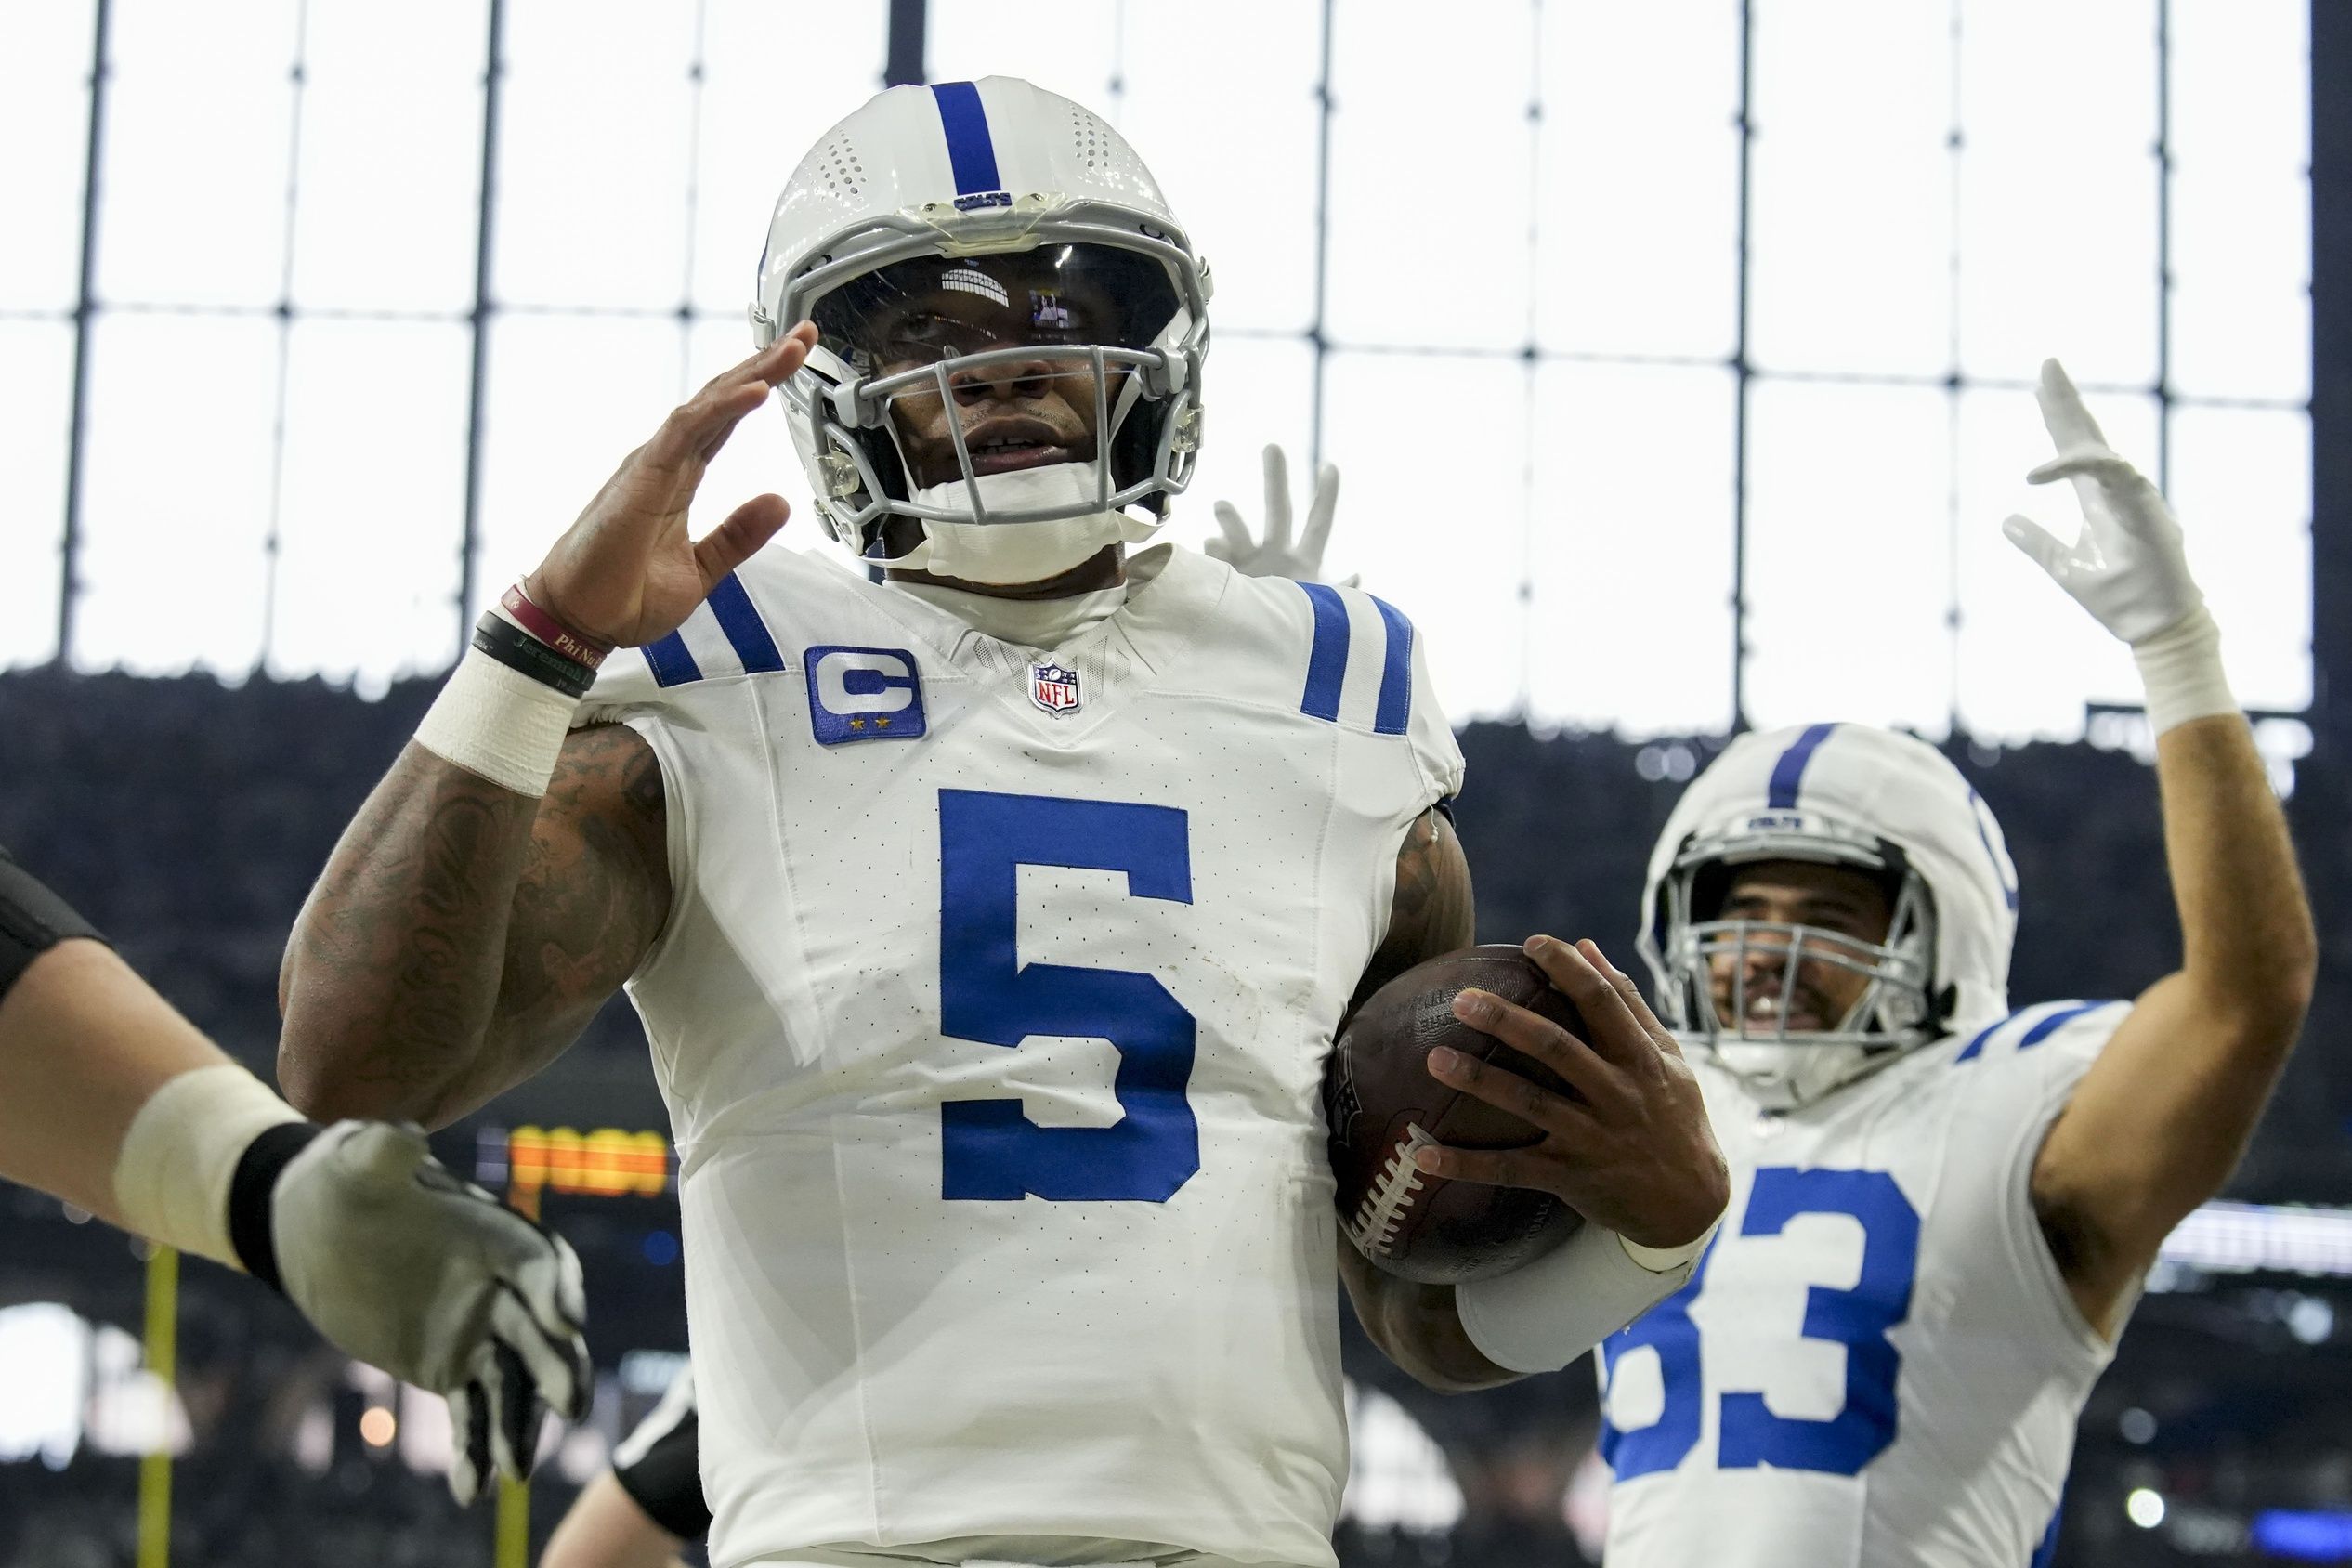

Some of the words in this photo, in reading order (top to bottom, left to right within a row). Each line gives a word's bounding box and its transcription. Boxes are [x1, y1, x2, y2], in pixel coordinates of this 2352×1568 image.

[954, 193, 1012, 211] COLTS
[513, 636, 582, 680] Jeremiah
[555, 634, 581, 656] Phi
[580, 647, 594, 665] Nu
[816, 652, 912, 715] C
[1037, 681, 1075, 707] NFL
[941, 790, 1199, 1202] 5
[1601, 1168, 1920, 1483] 83
